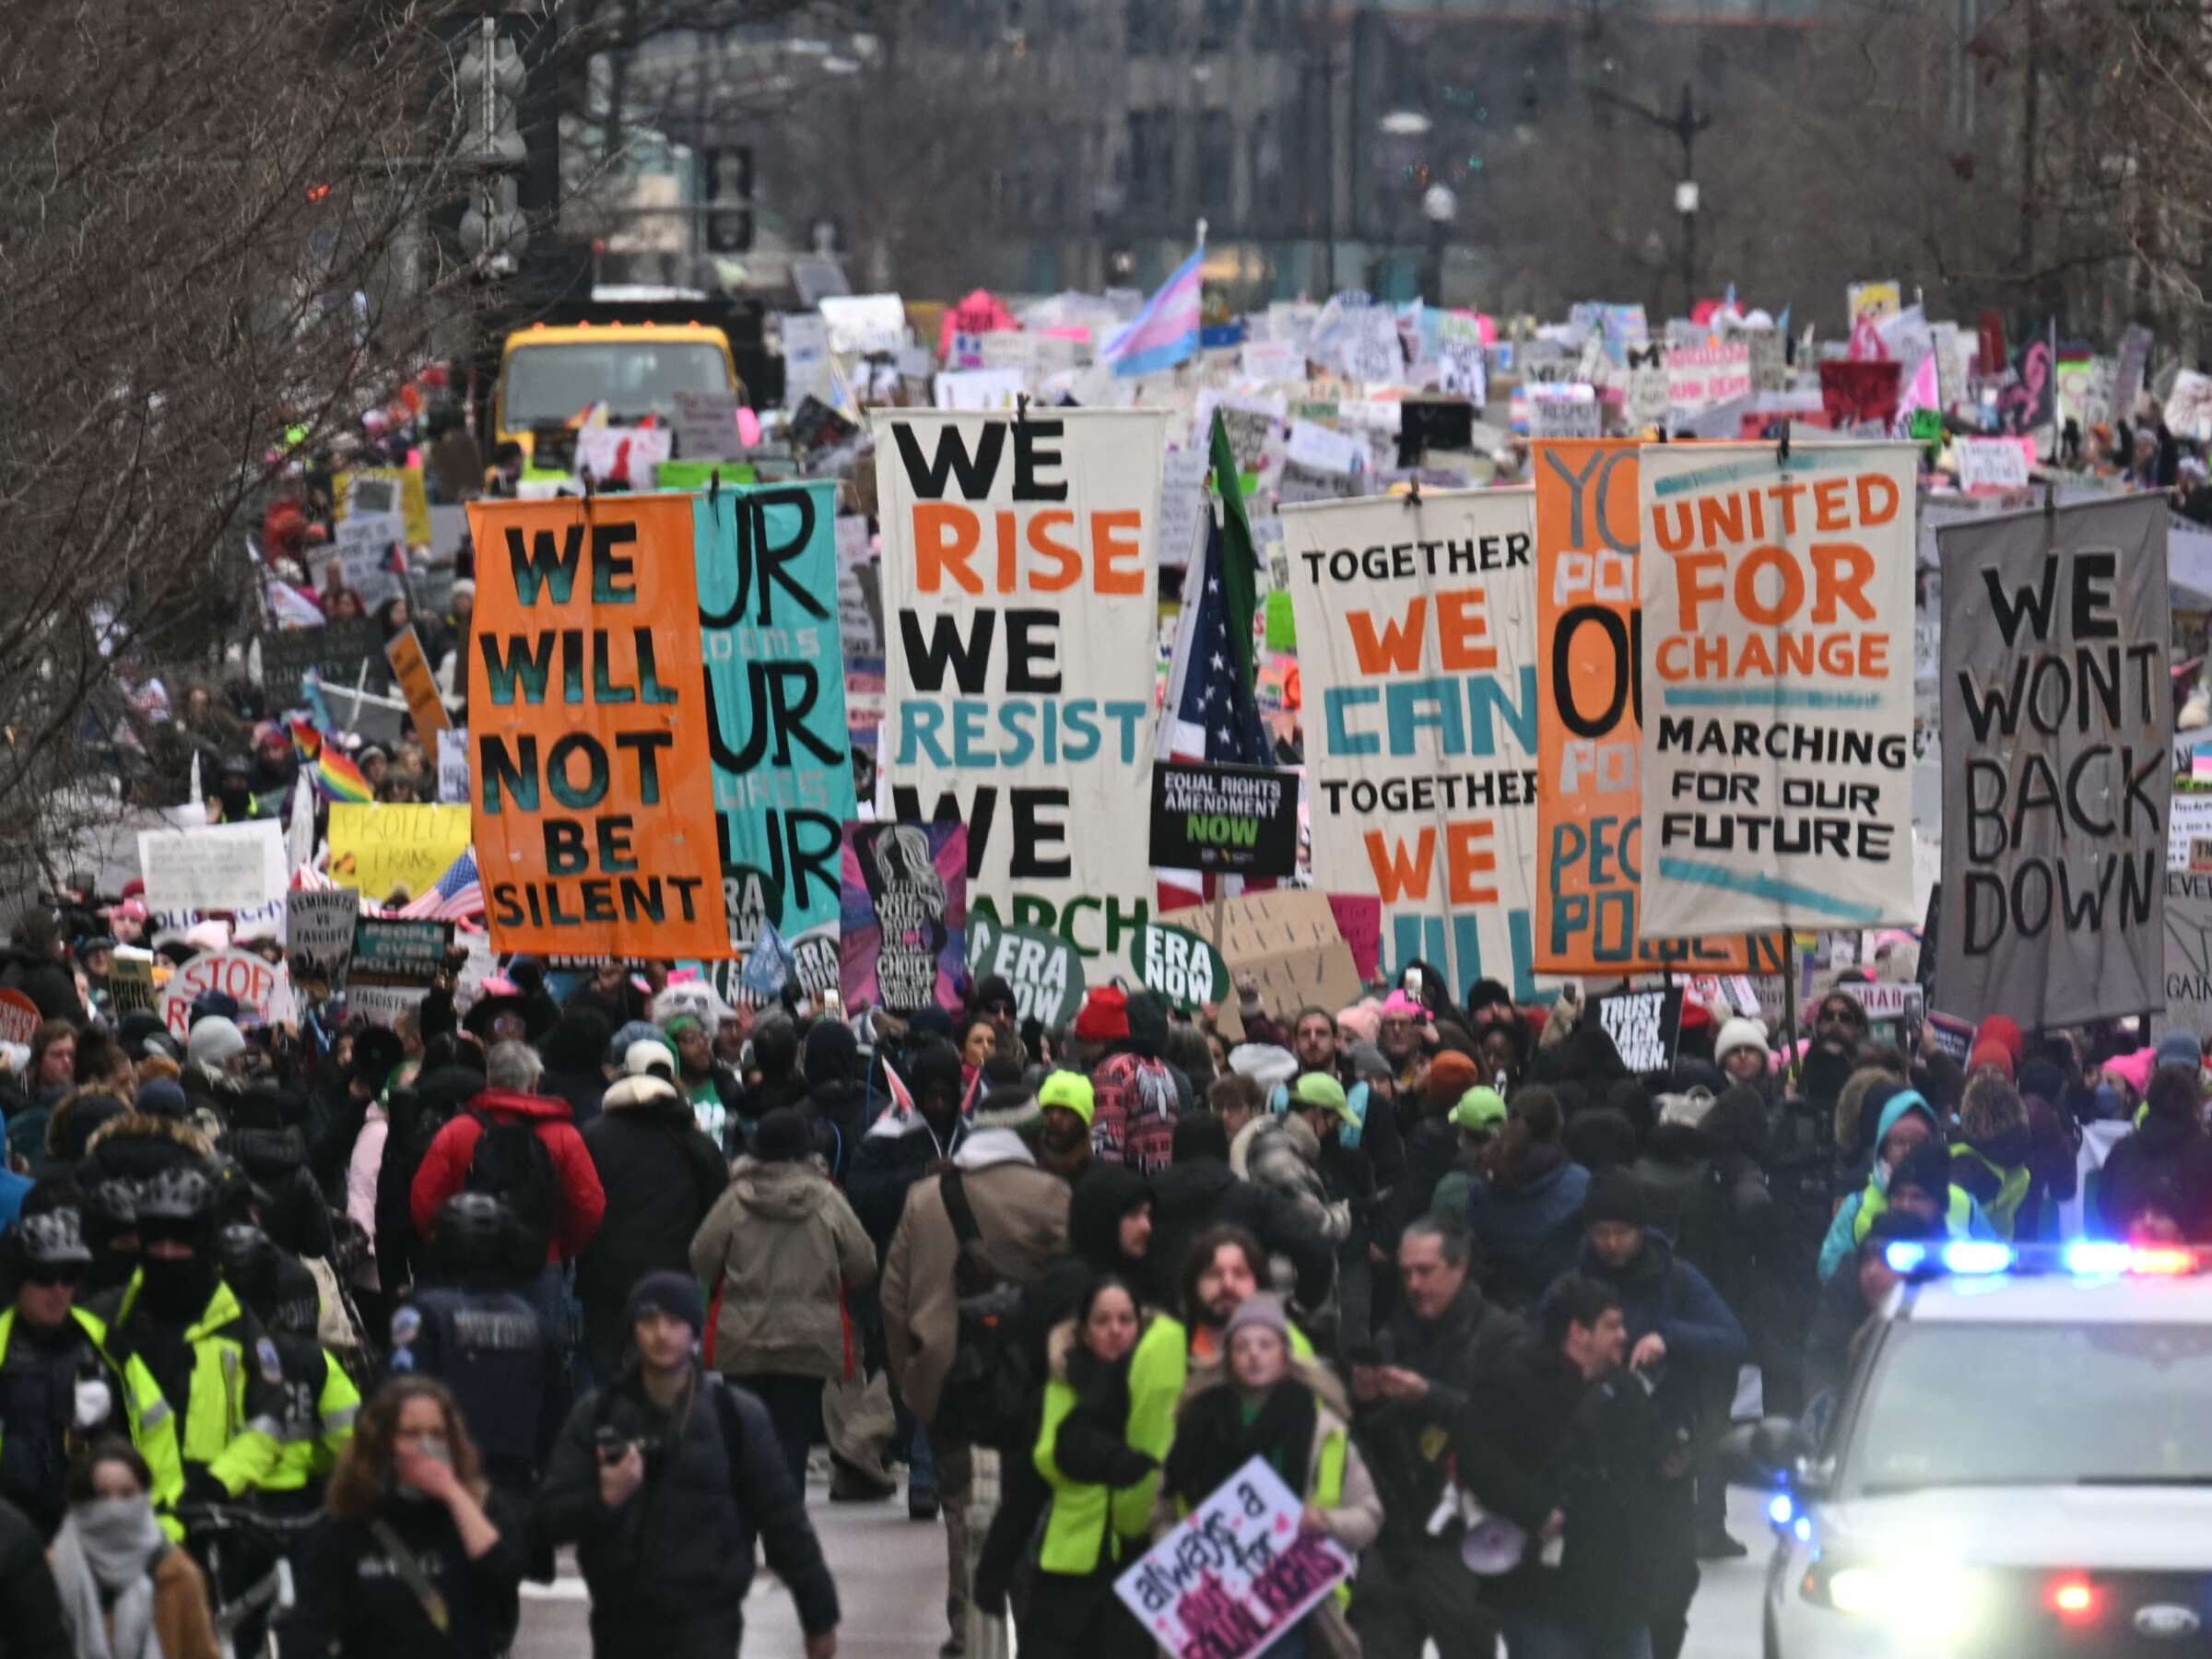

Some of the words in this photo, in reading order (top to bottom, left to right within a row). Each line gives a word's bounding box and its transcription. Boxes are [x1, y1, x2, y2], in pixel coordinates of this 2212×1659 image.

[890, 419, 1067, 501] WE
[1652, 472, 1900, 553] UNITED
[505, 521, 638, 606] WE
[912, 502, 1145, 594] RISE
[1301, 531, 1531, 585] TOGETHER
[1673, 542, 1877, 632] FOR
[1982, 553, 2120, 647] WE
[899, 607, 1063, 694] WE
[1346, 586, 1498, 677] WE
[1655, 632, 1889, 682] CHANGE
[478, 625, 678, 706] WILL
[1958, 642, 2159, 744] WONT
[894, 698, 1147, 768] RESIST
[1324, 664, 1537, 757] CAN
[1656, 714, 1907, 770] MARCHING
[479, 731, 674, 815] NOT
[1164, 771, 1213, 793] EQUAL
[1221, 775, 1281, 798] RIGHTS
[1671, 770, 1760, 807] FOR
[1783, 777, 1880, 818] OUR
[893, 785, 1071, 878] WE
[1164, 791, 1279, 818] AMENDMENT
[1186, 812, 1259, 848] NOW
[1965, 744, 2166, 865] BACK
[368, 847, 436, 872] TRANS
[542, 815, 639, 877] BE
[1363, 819, 1500, 907] WE
[1661, 811, 1895, 862] FUTURE
[493, 877, 702, 928] SILENT
[722, 872, 766, 914] RA
[1963, 847, 2156, 956] DOWN
[297, 927, 349, 945] FASCISTS
[364, 923, 446, 940] PEOPLE
[375, 941, 433, 958] OVER
[1145, 924, 1213, 971] ERA
[184, 956, 274, 1003] STOP
[351, 957, 442, 973] POLITIC
[993, 931, 1067, 991] ERA
[1145, 957, 1214, 1005] NOW
[1008, 976, 1065, 1029] OW
[1600, 991, 1666, 1025] TRUST
[1606, 1016, 1661, 1046] LACK
[1133, 1509, 1226, 1611] always
[1235, 1480, 1266, 1518] a
